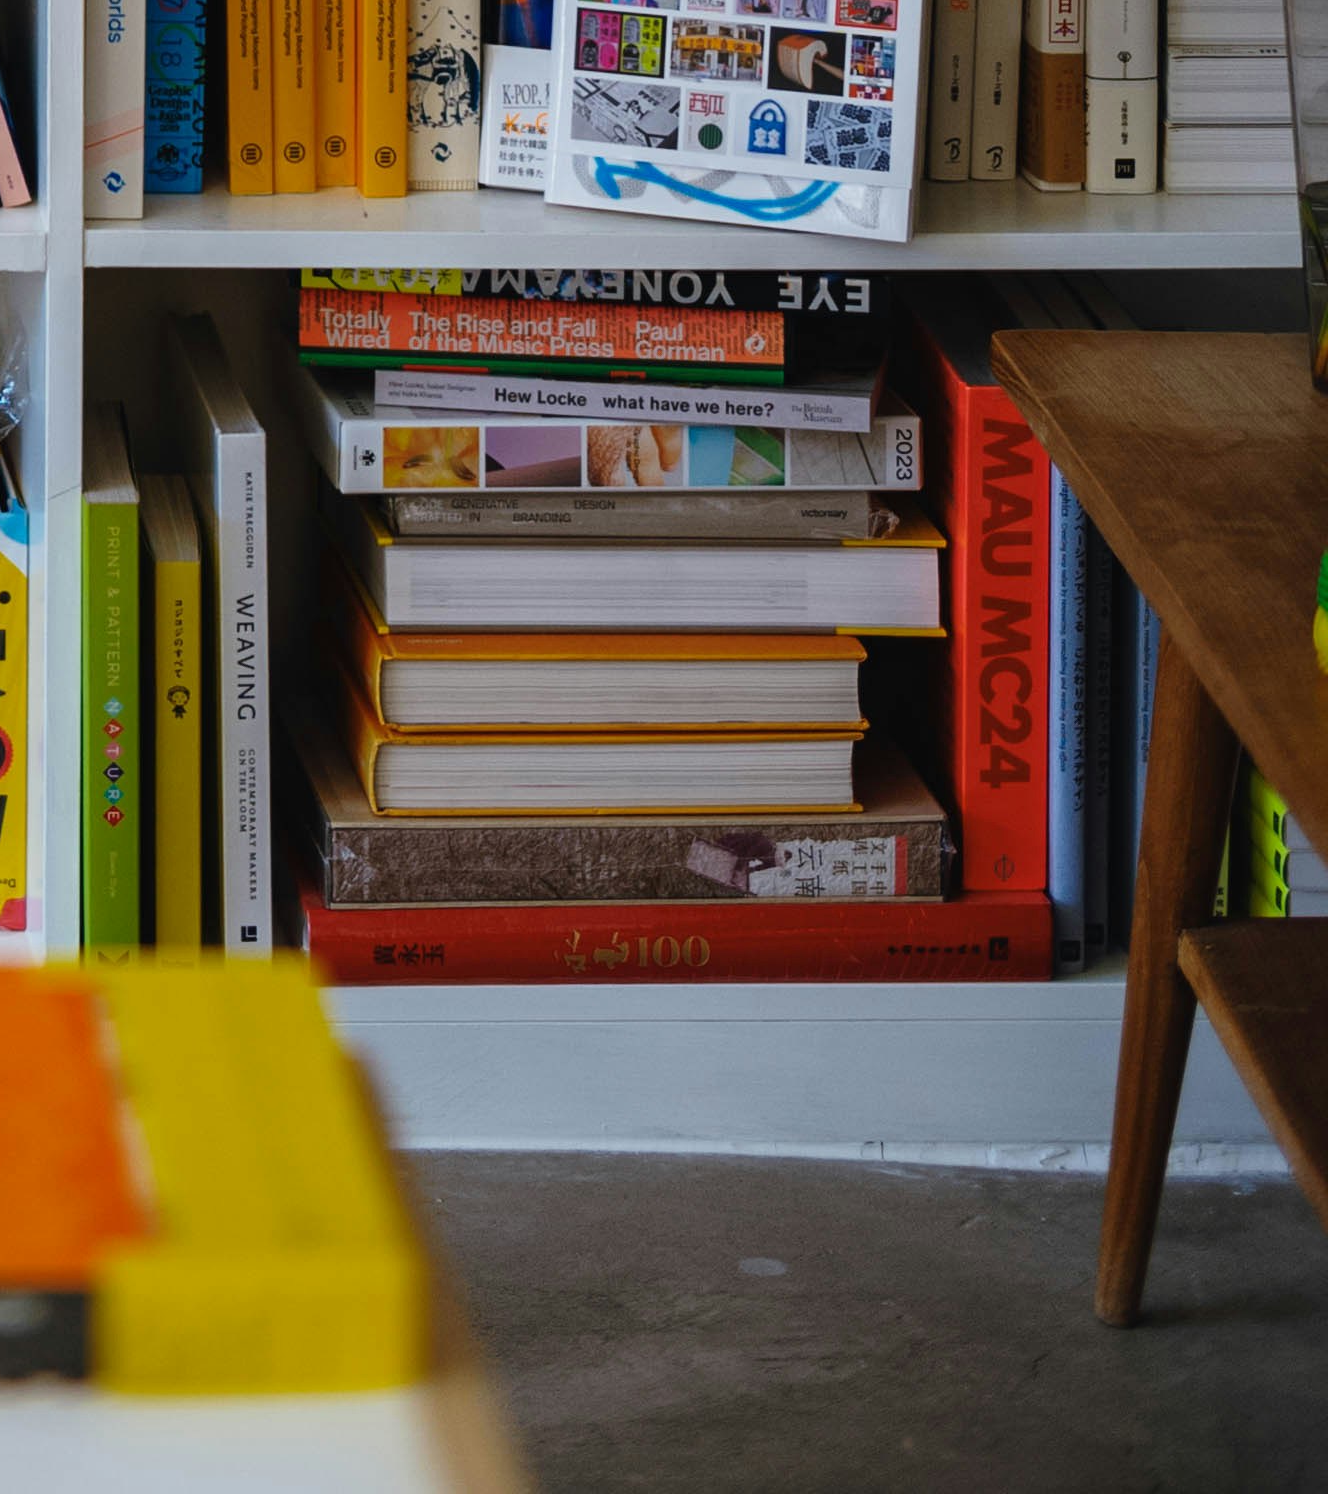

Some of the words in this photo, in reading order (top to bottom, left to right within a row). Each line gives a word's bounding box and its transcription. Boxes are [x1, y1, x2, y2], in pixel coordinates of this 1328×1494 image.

[776, 274, 873, 312] EYE
[494, 387, 532, 404] Hew
[537, 388, 587, 407] Locke
[602, 393, 646, 411] what
[650, 396, 691, 413] have
[695, 403, 719, 415] we
[725, 399, 774, 418] here?
[235, 593, 257, 723] WEAVING
